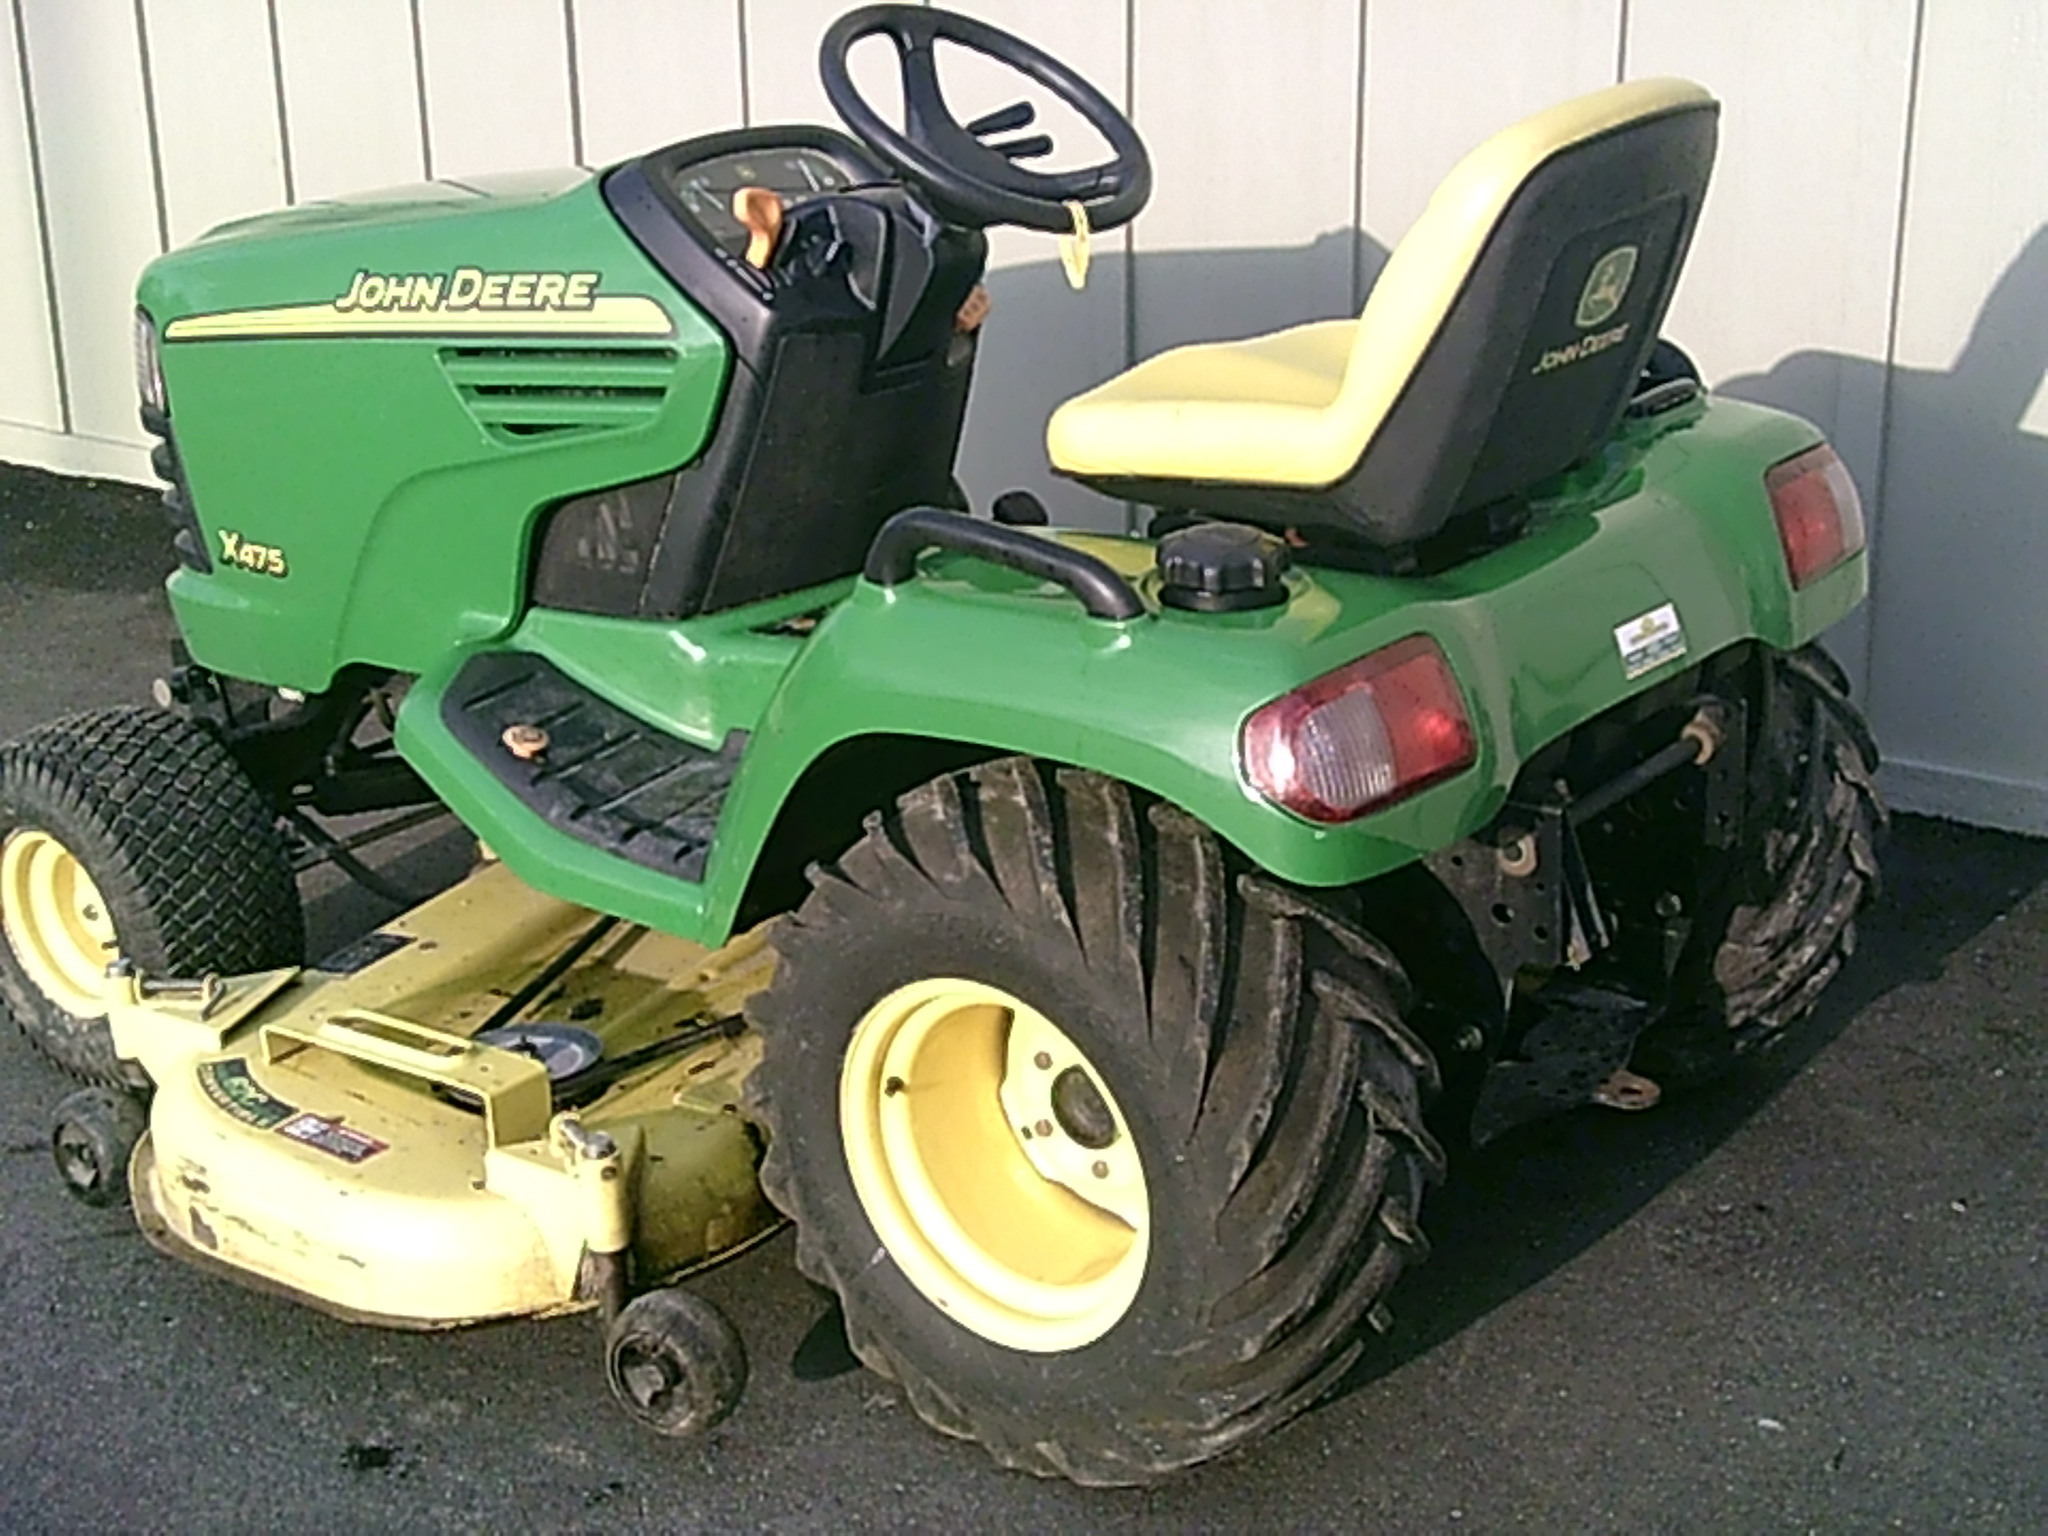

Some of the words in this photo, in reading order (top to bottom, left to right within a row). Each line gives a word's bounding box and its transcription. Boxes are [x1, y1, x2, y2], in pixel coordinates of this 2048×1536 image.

[335, 269, 446, 311] JOHN
[446, 266, 601, 311] DEERE
[217, 529, 286, 575] X475
